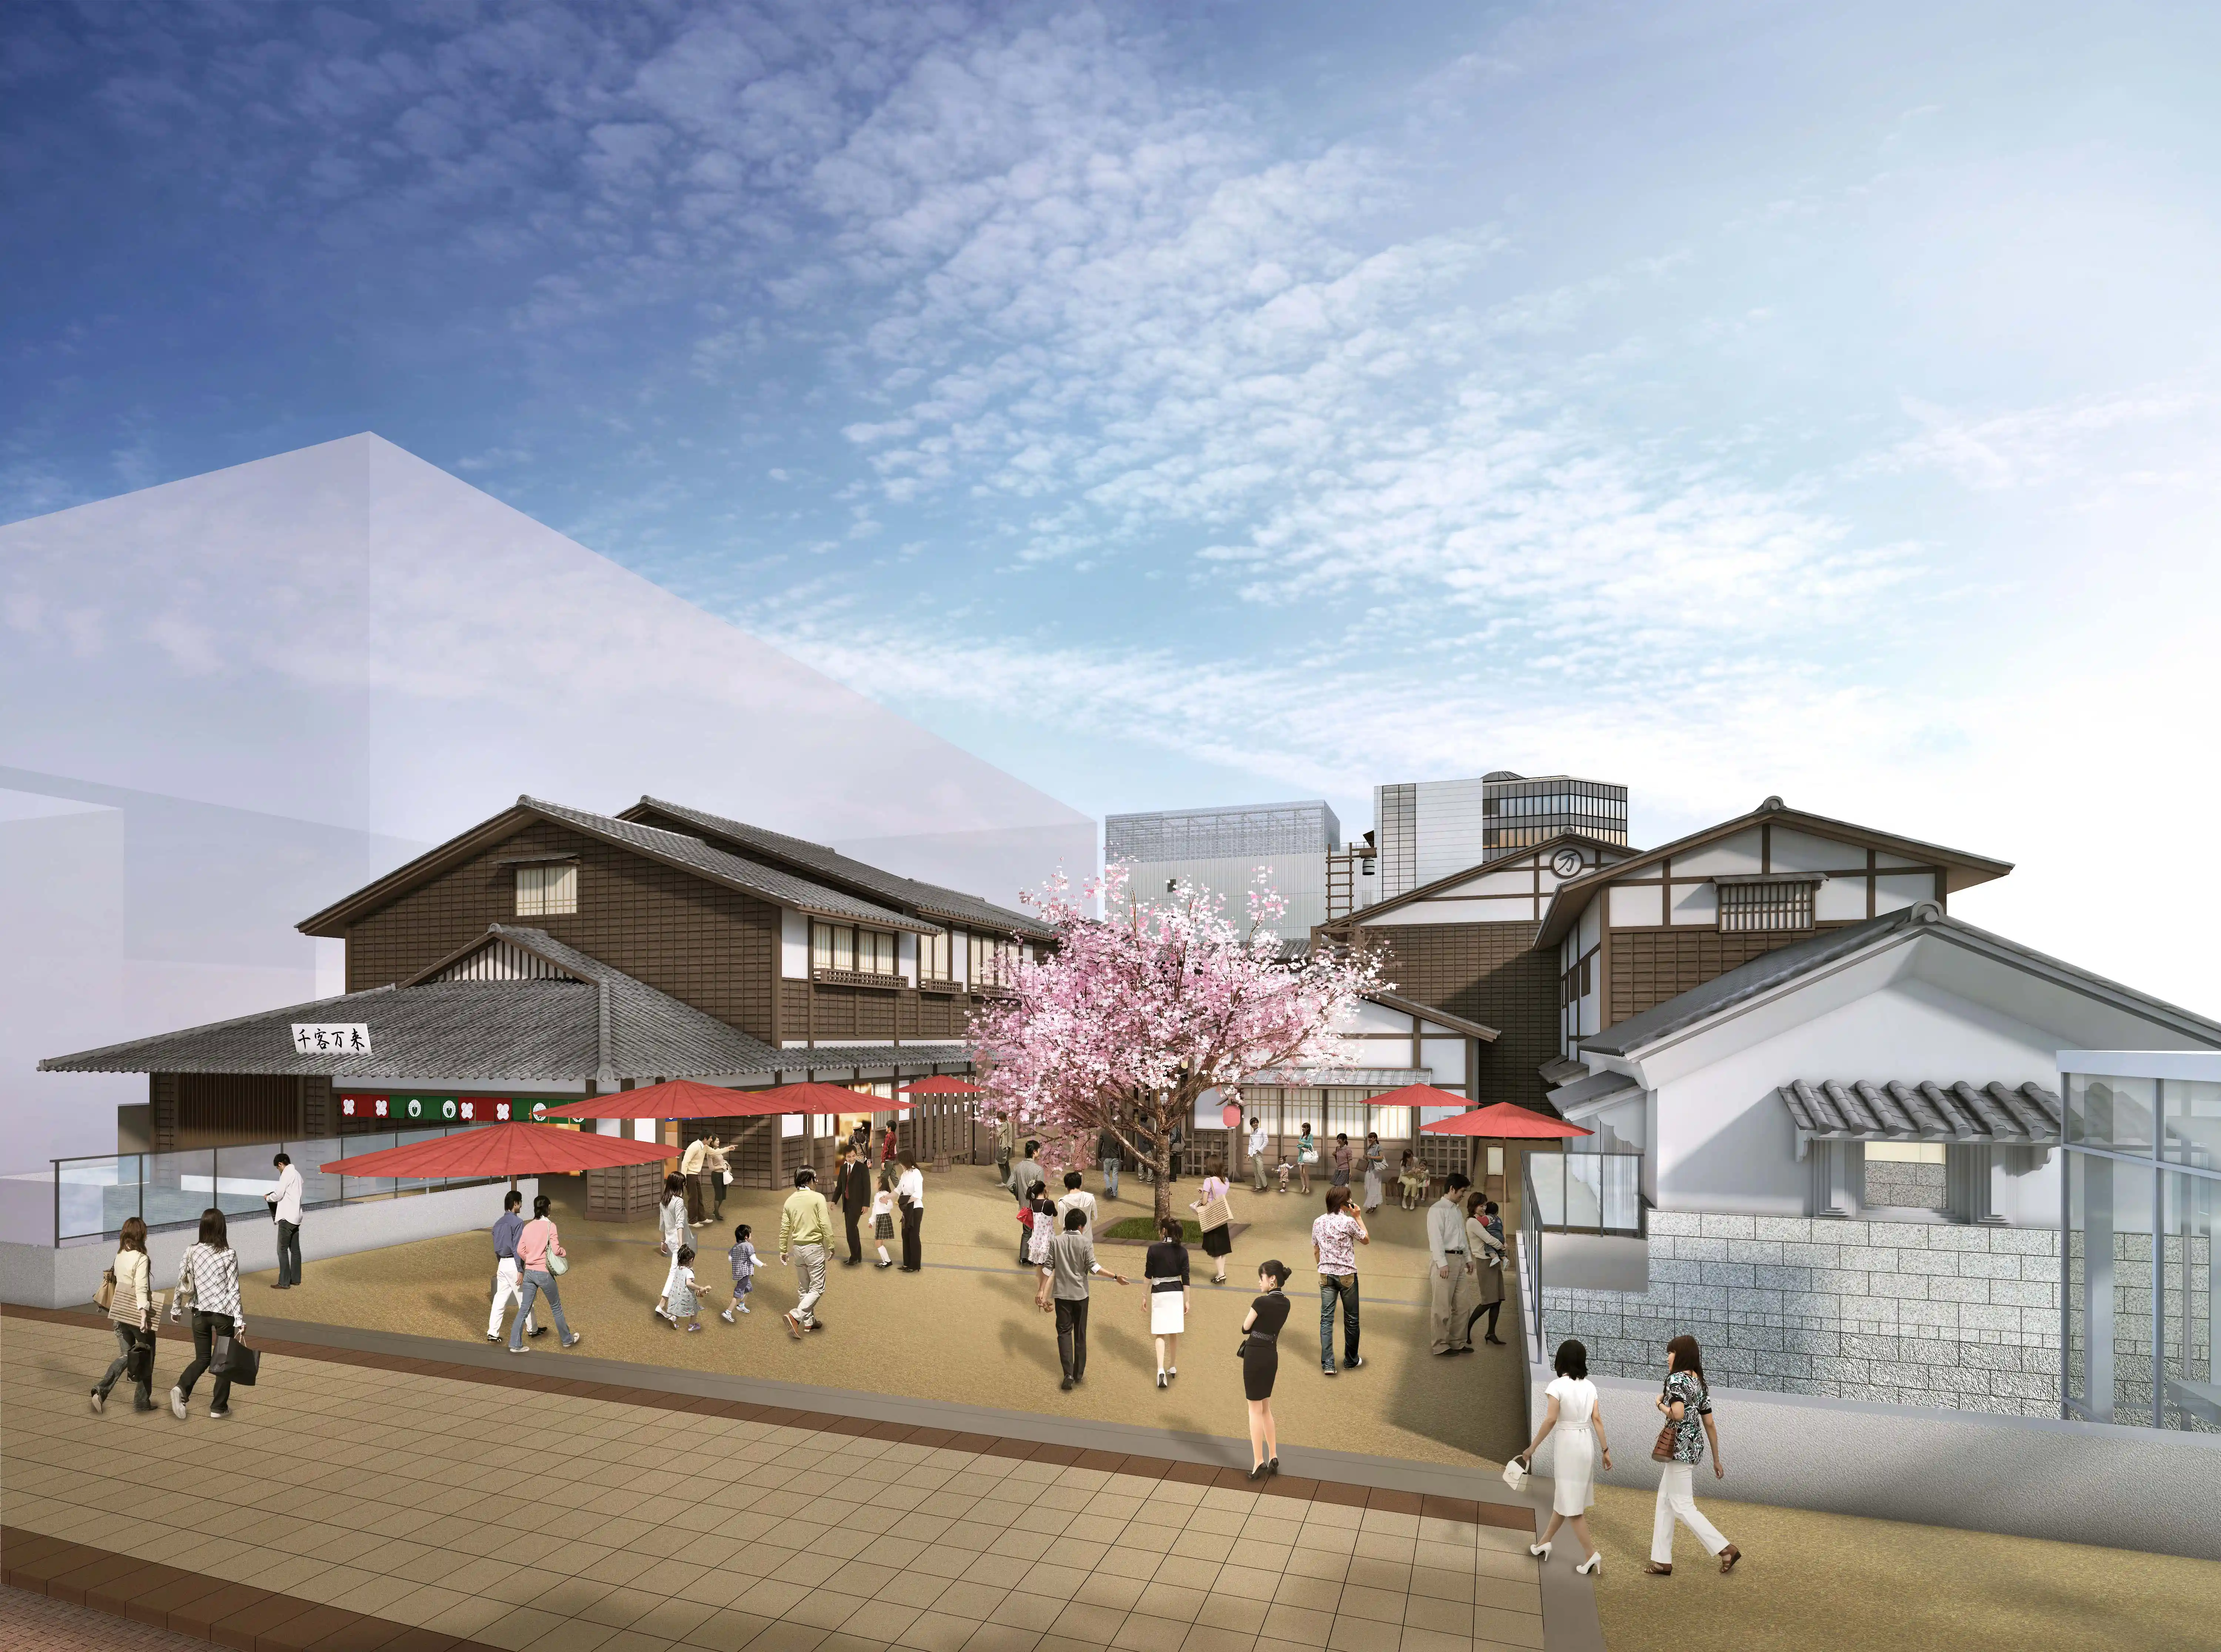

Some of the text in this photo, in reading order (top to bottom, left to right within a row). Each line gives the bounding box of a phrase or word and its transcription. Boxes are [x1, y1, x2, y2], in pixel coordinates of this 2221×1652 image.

[1556, 852, 1577, 872] 万
[297, 1028, 365, 1051] 千客万来
